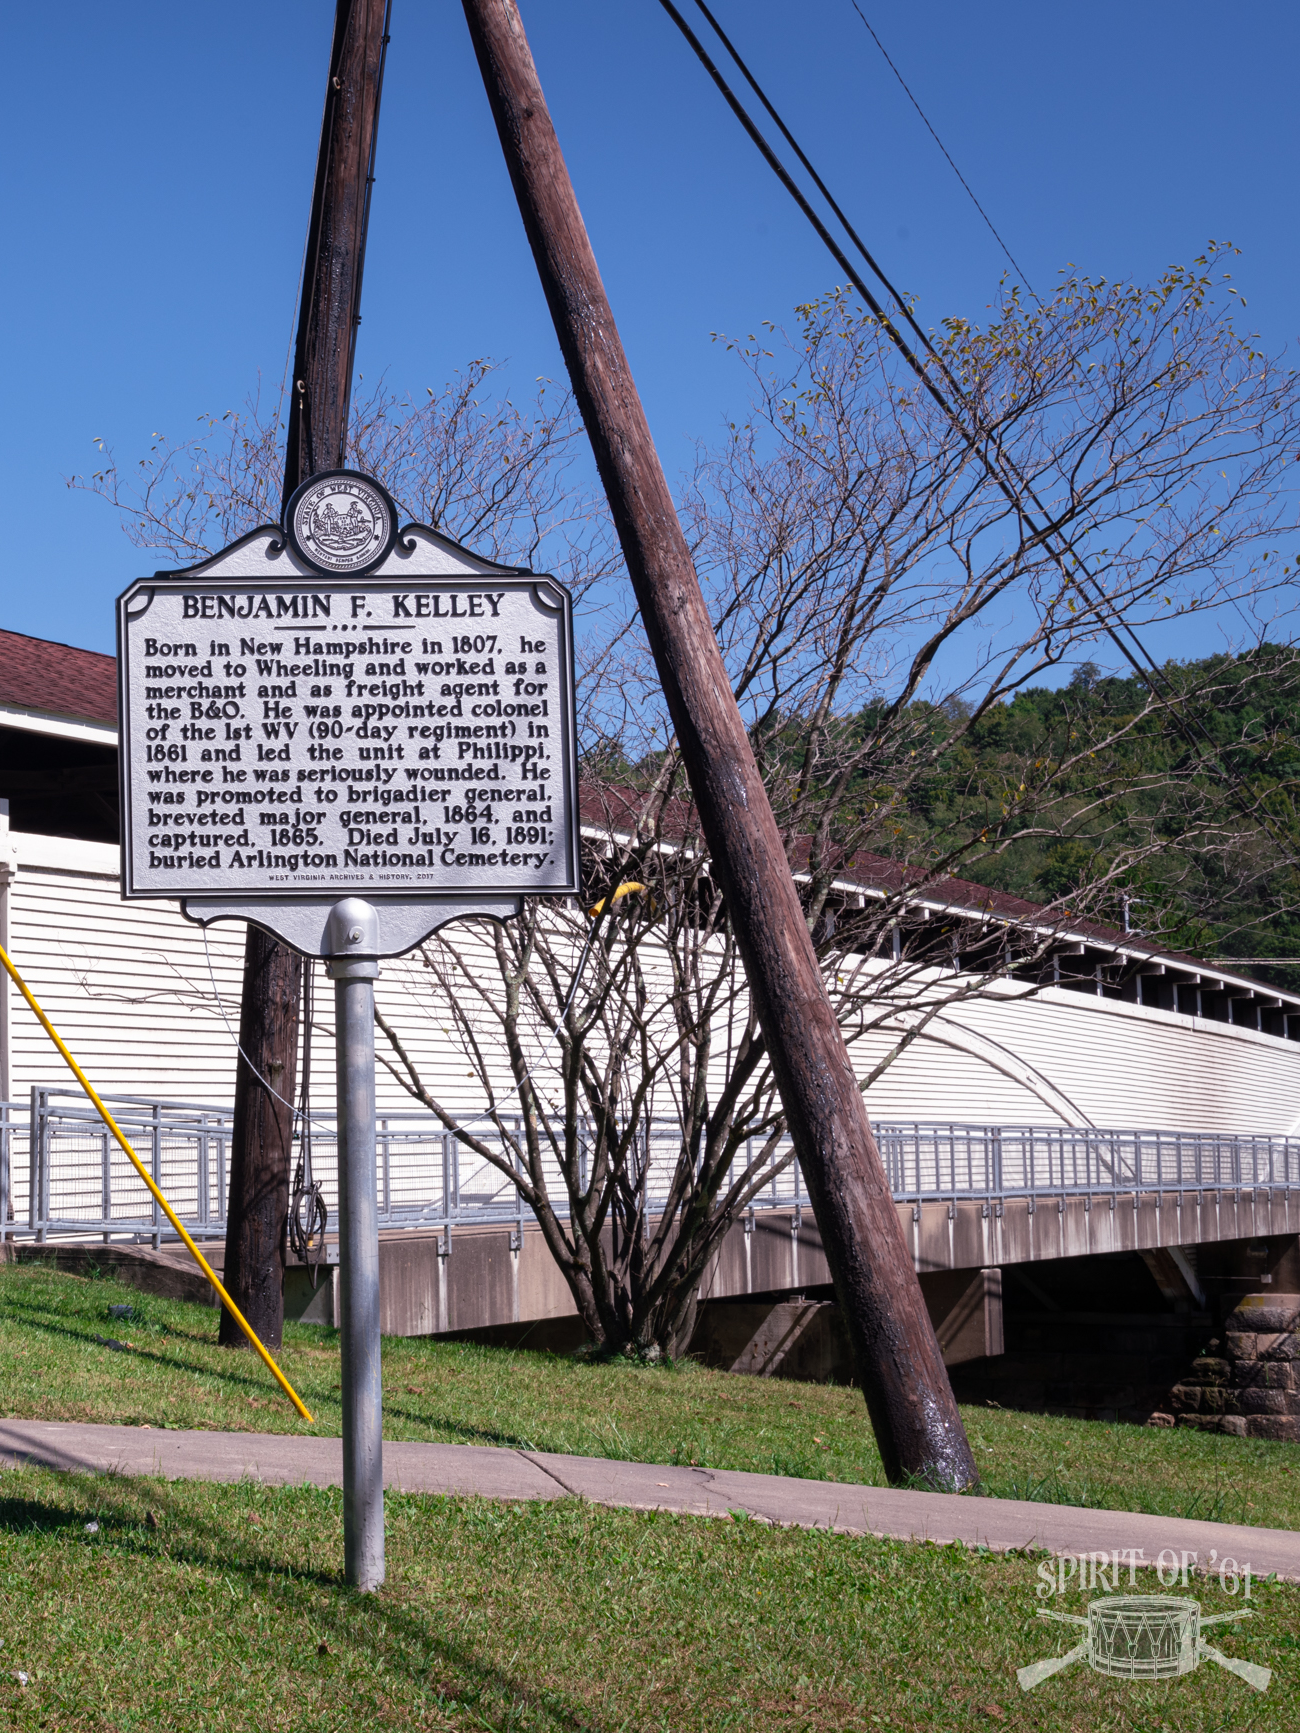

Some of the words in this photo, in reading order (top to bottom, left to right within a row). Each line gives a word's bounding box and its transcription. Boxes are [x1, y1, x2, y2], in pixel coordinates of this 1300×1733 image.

[302, 501, 315, 526] STATE
[316, 489, 325, 499] OF
[330, 485, 353, 493] WEST
[182, 593, 332, 620] BENJAMIN
[351, 593, 373, 618] F.
[393, 592, 505, 618] KELLEY
[144, 638, 198, 657] Born
[209, 639, 231, 657] in
[239, 637, 284, 657] New
[293, 636, 413, 661] Hampshire
[421, 637, 444, 655] in
[451, 634, 503, 656] 1807,
[519, 635, 547, 654] he
[145, 659, 214, 679] moved
[222, 660, 247, 678] to
[254, 657, 355, 682] Wheeling
[364, 657, 407, 677] and
[414, 657, 496, 676] worked
[504, 661, 528, 676] as
[534, 661, 548, 675] a
[145, 680, 247, 700] merchant
[257, 680, 298, 699] and
[310, 684, 333, 698] as
[344, 678, 425, 703] freight
[440, 679, 500, 703] agent
[512, 677, 548, 697] for
[145, 702, 182, 721] the
[189, 700, 245, 720] B&O.
[262, 700, 293, 720] He
[303, 705, 342, 719] was
[351, 698, 464, 725] appointed
[471, 699, 549, 718] colonel
[145, 723, 171, 742] of
[179, 722, 217, 742] the
[261, 721, 299, 740] WV
[308, 720, 399, 745] (90-day
[407, 720, 517, 745] regiment)
[527, 720, 550, 739] in
[146, 743, 188, 763] 1861
[200, 743, 242, 763] and
[256, 742, 292, 762] led
[306, 742, 344, 762] the
[358, 740, 405, 761] unit
[418, 740, 442, 761] at
[457, 741, 551, 766] Philippi,
[146, 765, 214, 784] where
[221, 765, 248, 784] he
[252, 769, 291, 783] was
[296, 763, 398, 787] seriously
[404, 762, 506, 782] wounded.
[520, 761, 551, 781] He
[147, 791, 186, 805] was
[195, 785, 303, 809] promoted
[313, 785, 339, 804] to
[346, 784, 452, 808] brigadier
[464, 783, 552, 807] general,
[147, 807, 246, 827] breveted
[258, 807, 327, 831] major
[339, 805, 428, 830] general,
[443, 805, 500, 826] 1864,
[512, 804, 553, 824] and
[148, 828, 256, 852] captured,
[270, 827, 324, 847] 1865.
[347, 827, 399, 847] Died
[407, 826, 459, 851] July
[470, 826, 497, 847] 16,
[505, 825, 555, 847] 1891;
[148, 847, 222, 869] buried
[228, 849, 339, 873] Arlington
[343, 848, 435, 868] National
[440, 846, 555, 874] Cemetery.
